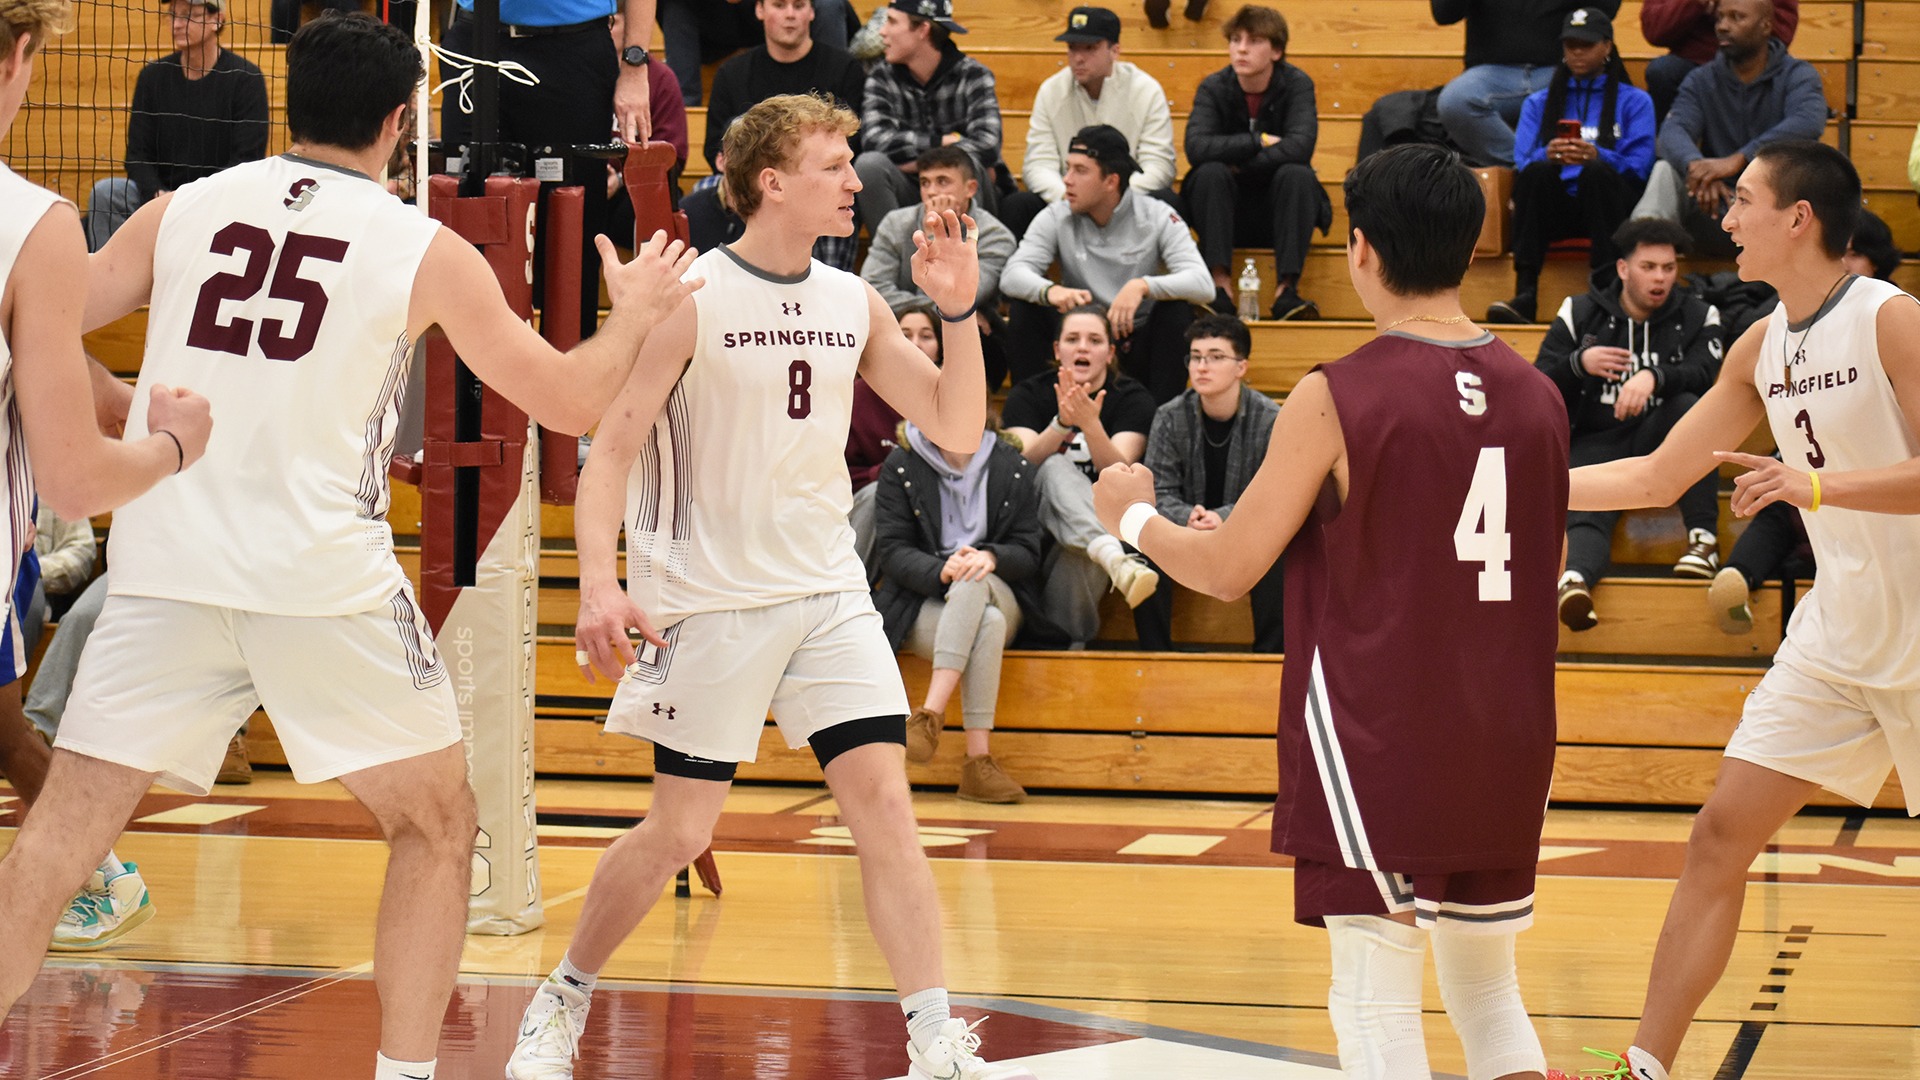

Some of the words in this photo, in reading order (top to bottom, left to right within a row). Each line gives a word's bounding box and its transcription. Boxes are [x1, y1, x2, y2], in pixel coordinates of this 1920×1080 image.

[283, 178, 320, 212] S
[186, 221, 350, 361] 25
[724, 330, 856, 348] SPRINGFIELD
[787, 360, 812, 419] 8
[1455, 371, 1487, 416] S
[1795, 409, 1825, 469] 3
[1453, 447, 1511, 601] 4
[452, 625, 476, 705] sports
